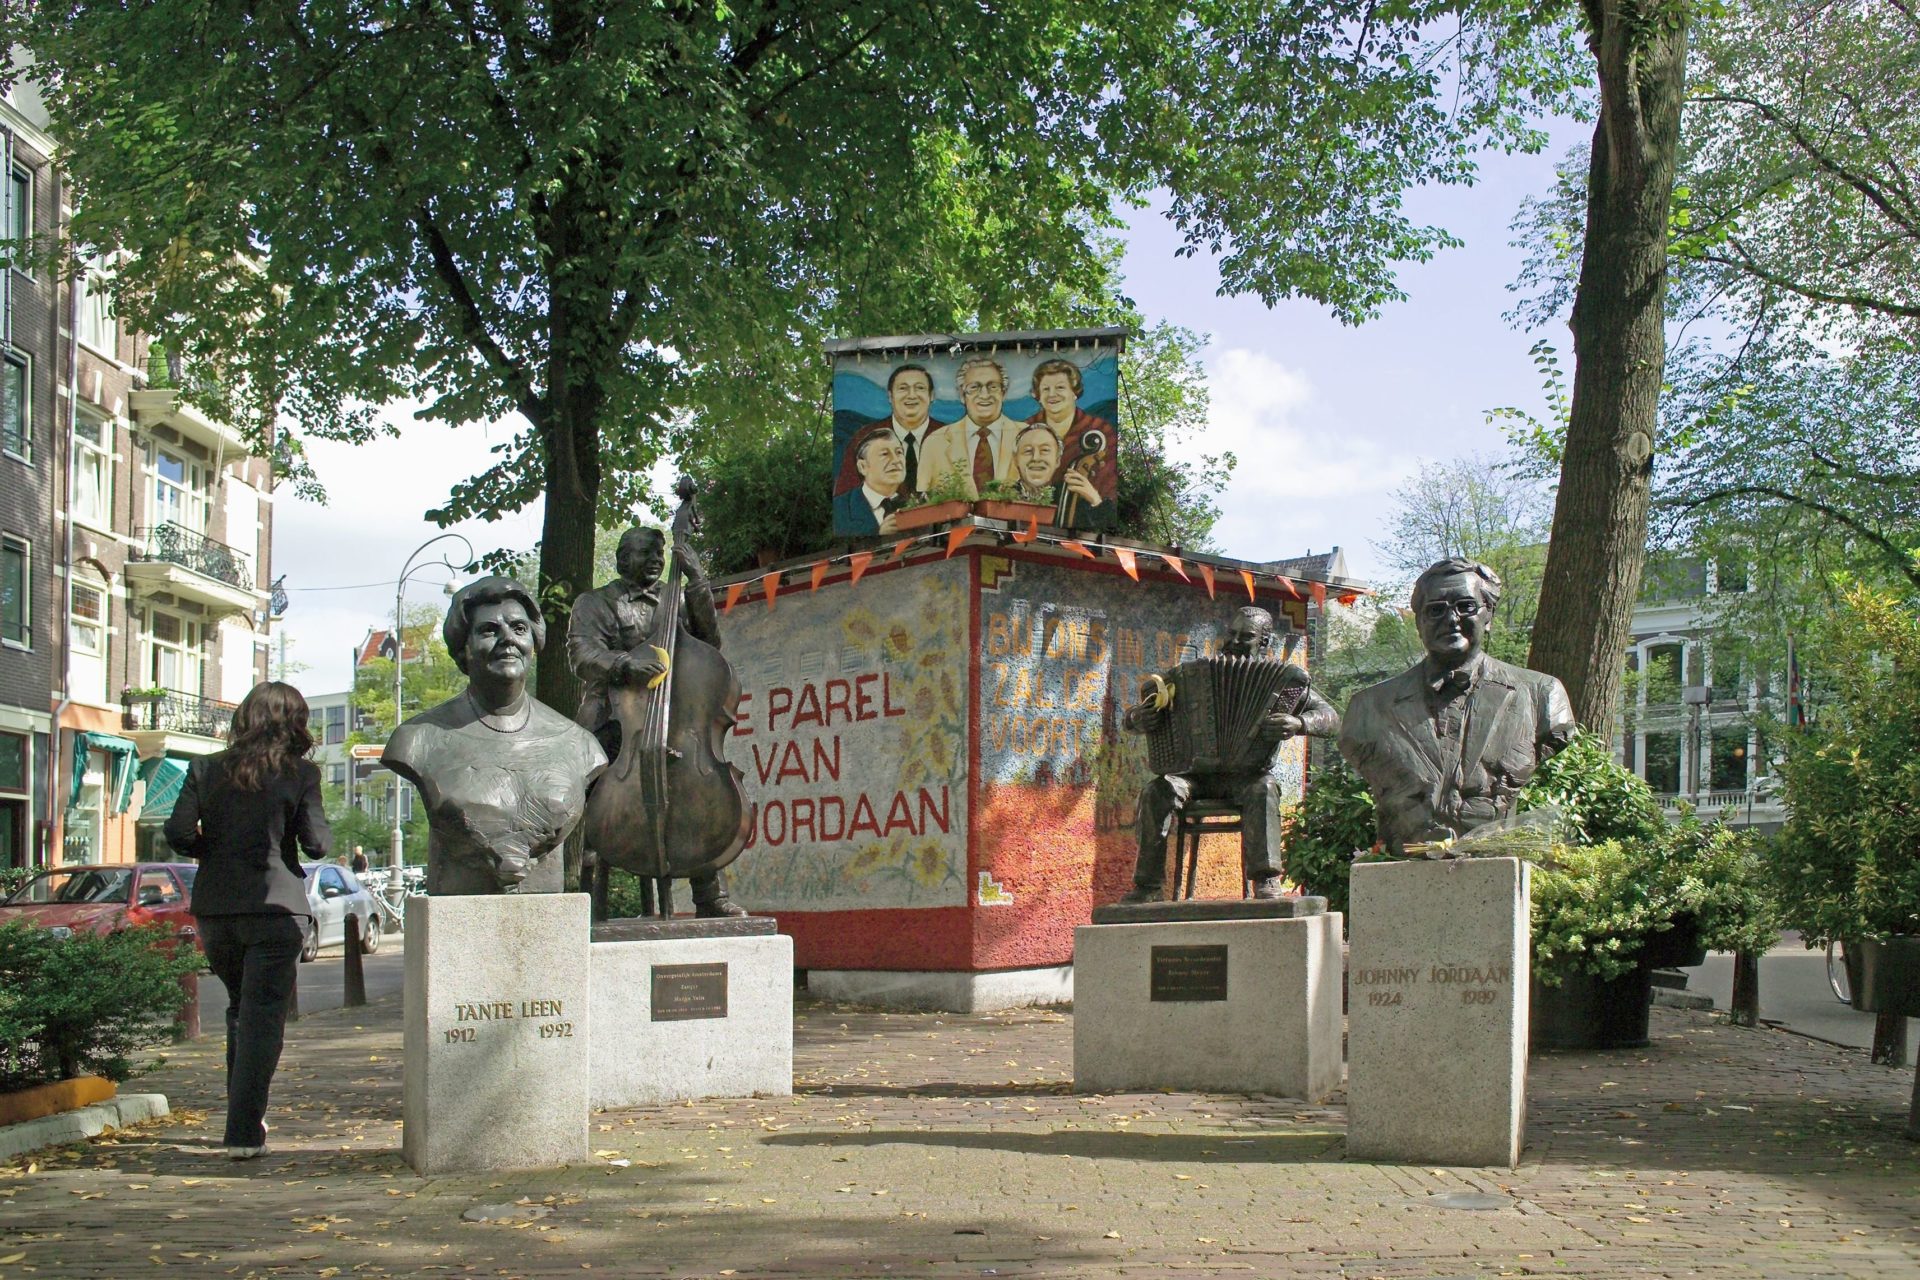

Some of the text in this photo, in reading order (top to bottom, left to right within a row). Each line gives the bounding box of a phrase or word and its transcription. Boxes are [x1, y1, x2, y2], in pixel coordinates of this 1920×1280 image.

[1044, 616, 1107, 663] ONS
[732, 671, 906, 736] E PAREL
[991, 662, 1053, 708] ZAL
[1063, 667, 1102, 712] DE
[751, 735, 840, 785] VAN
[991, 713, 1084, 760] VOORT
[1354, 965, 1510, 985] JOHNNY JORDAAN
[1368, 990, 1497, 1007] 1924 1989
[444, 1020, 574, 1044] 1912 1992
[455, 999, 563, 1021] TANTE LEEN
